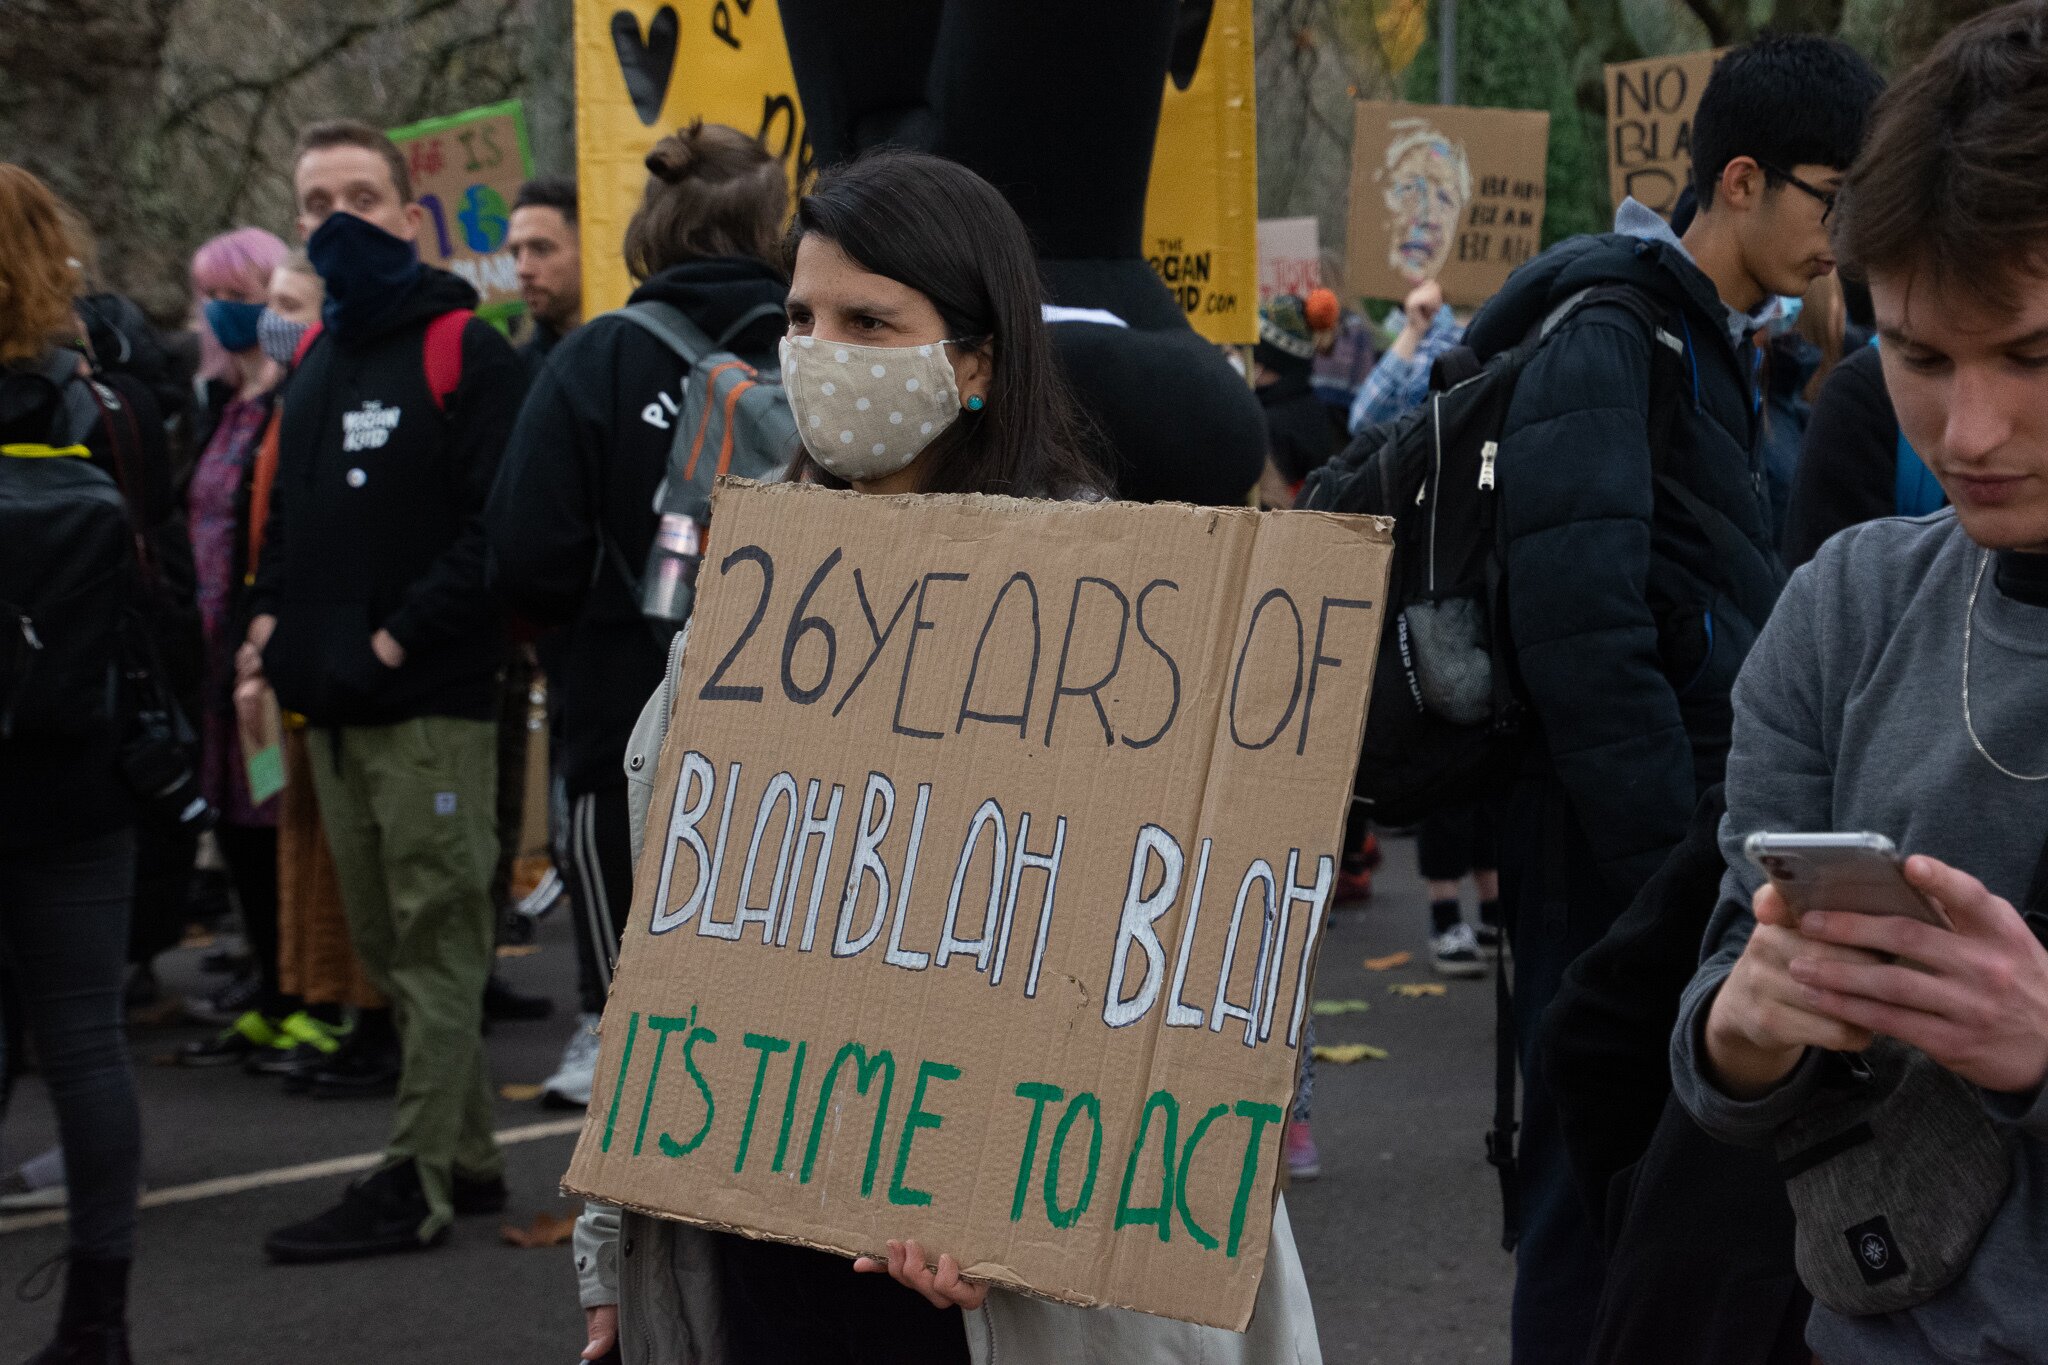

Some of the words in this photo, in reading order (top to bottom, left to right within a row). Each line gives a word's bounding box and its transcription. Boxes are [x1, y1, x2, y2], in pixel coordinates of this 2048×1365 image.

[1615, 64, 1687, 116] NO
[1229, 587, 1372, 757] OF
[648, 750, 845, 953] BLAH
[831, 769, 1067, 999] BLAH
[1101, 822, 1334, 1049] BLAH
[734, 1033, 962, 1207] TIME
[1010, 1082, 1103, 1231] TO
[1110, 1088, 1282, 1258] ACT
